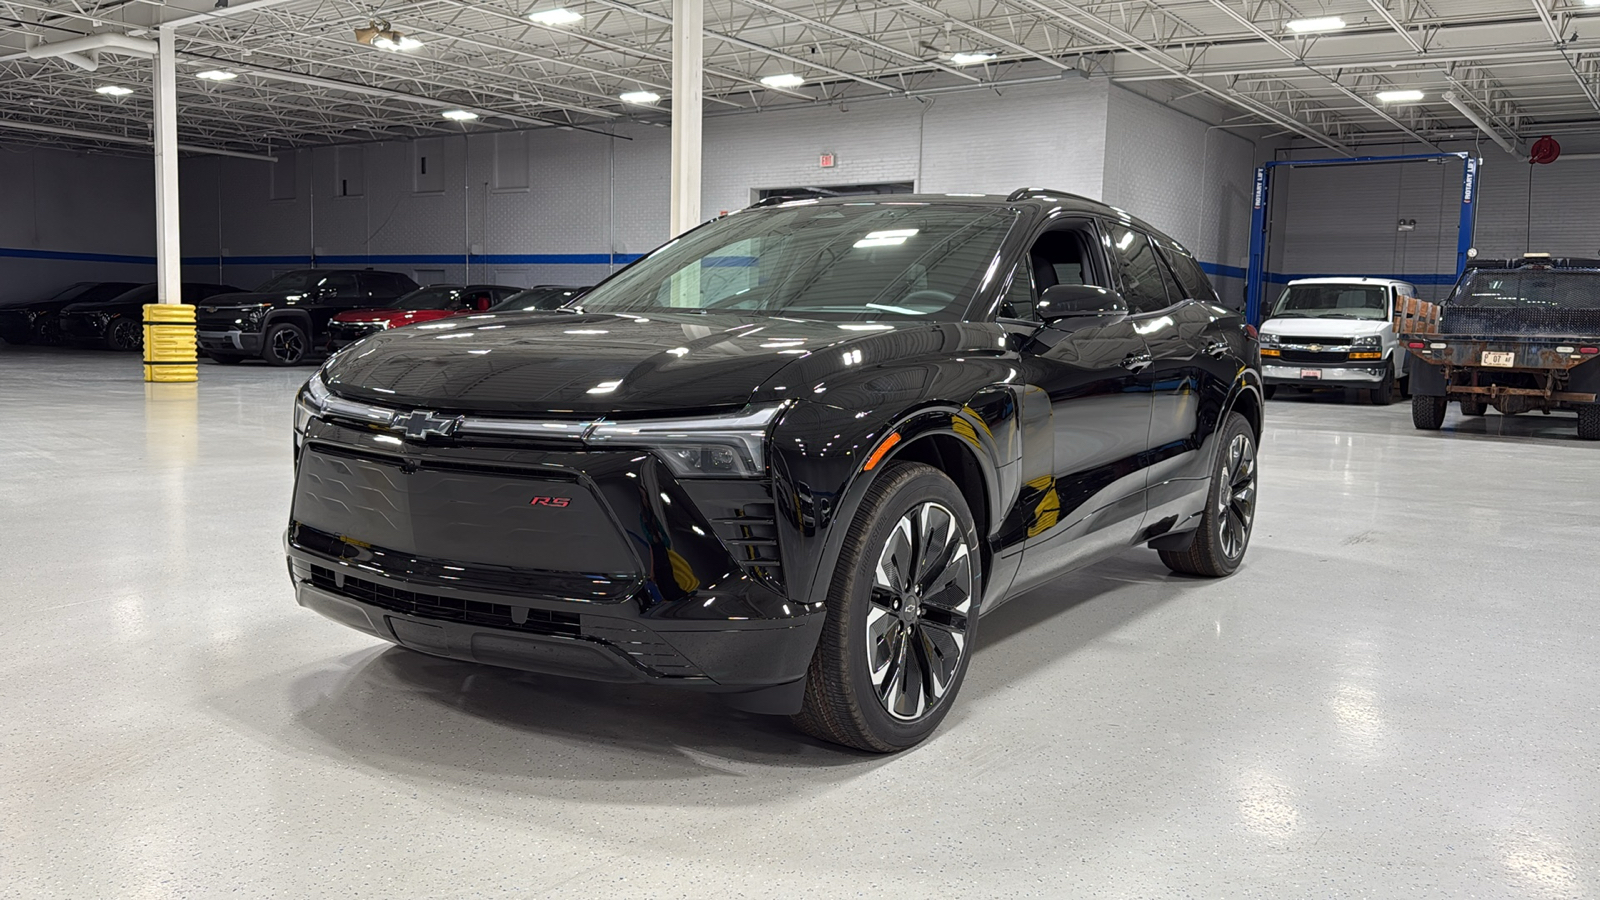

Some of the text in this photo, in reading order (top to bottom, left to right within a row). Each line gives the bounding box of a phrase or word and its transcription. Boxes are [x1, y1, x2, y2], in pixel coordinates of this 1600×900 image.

[1464, 158, 1475, 200] ROTARY LIFT
[1255, 182, 1263, 206] ROTARY
[530, 496, 571, 507] RS
